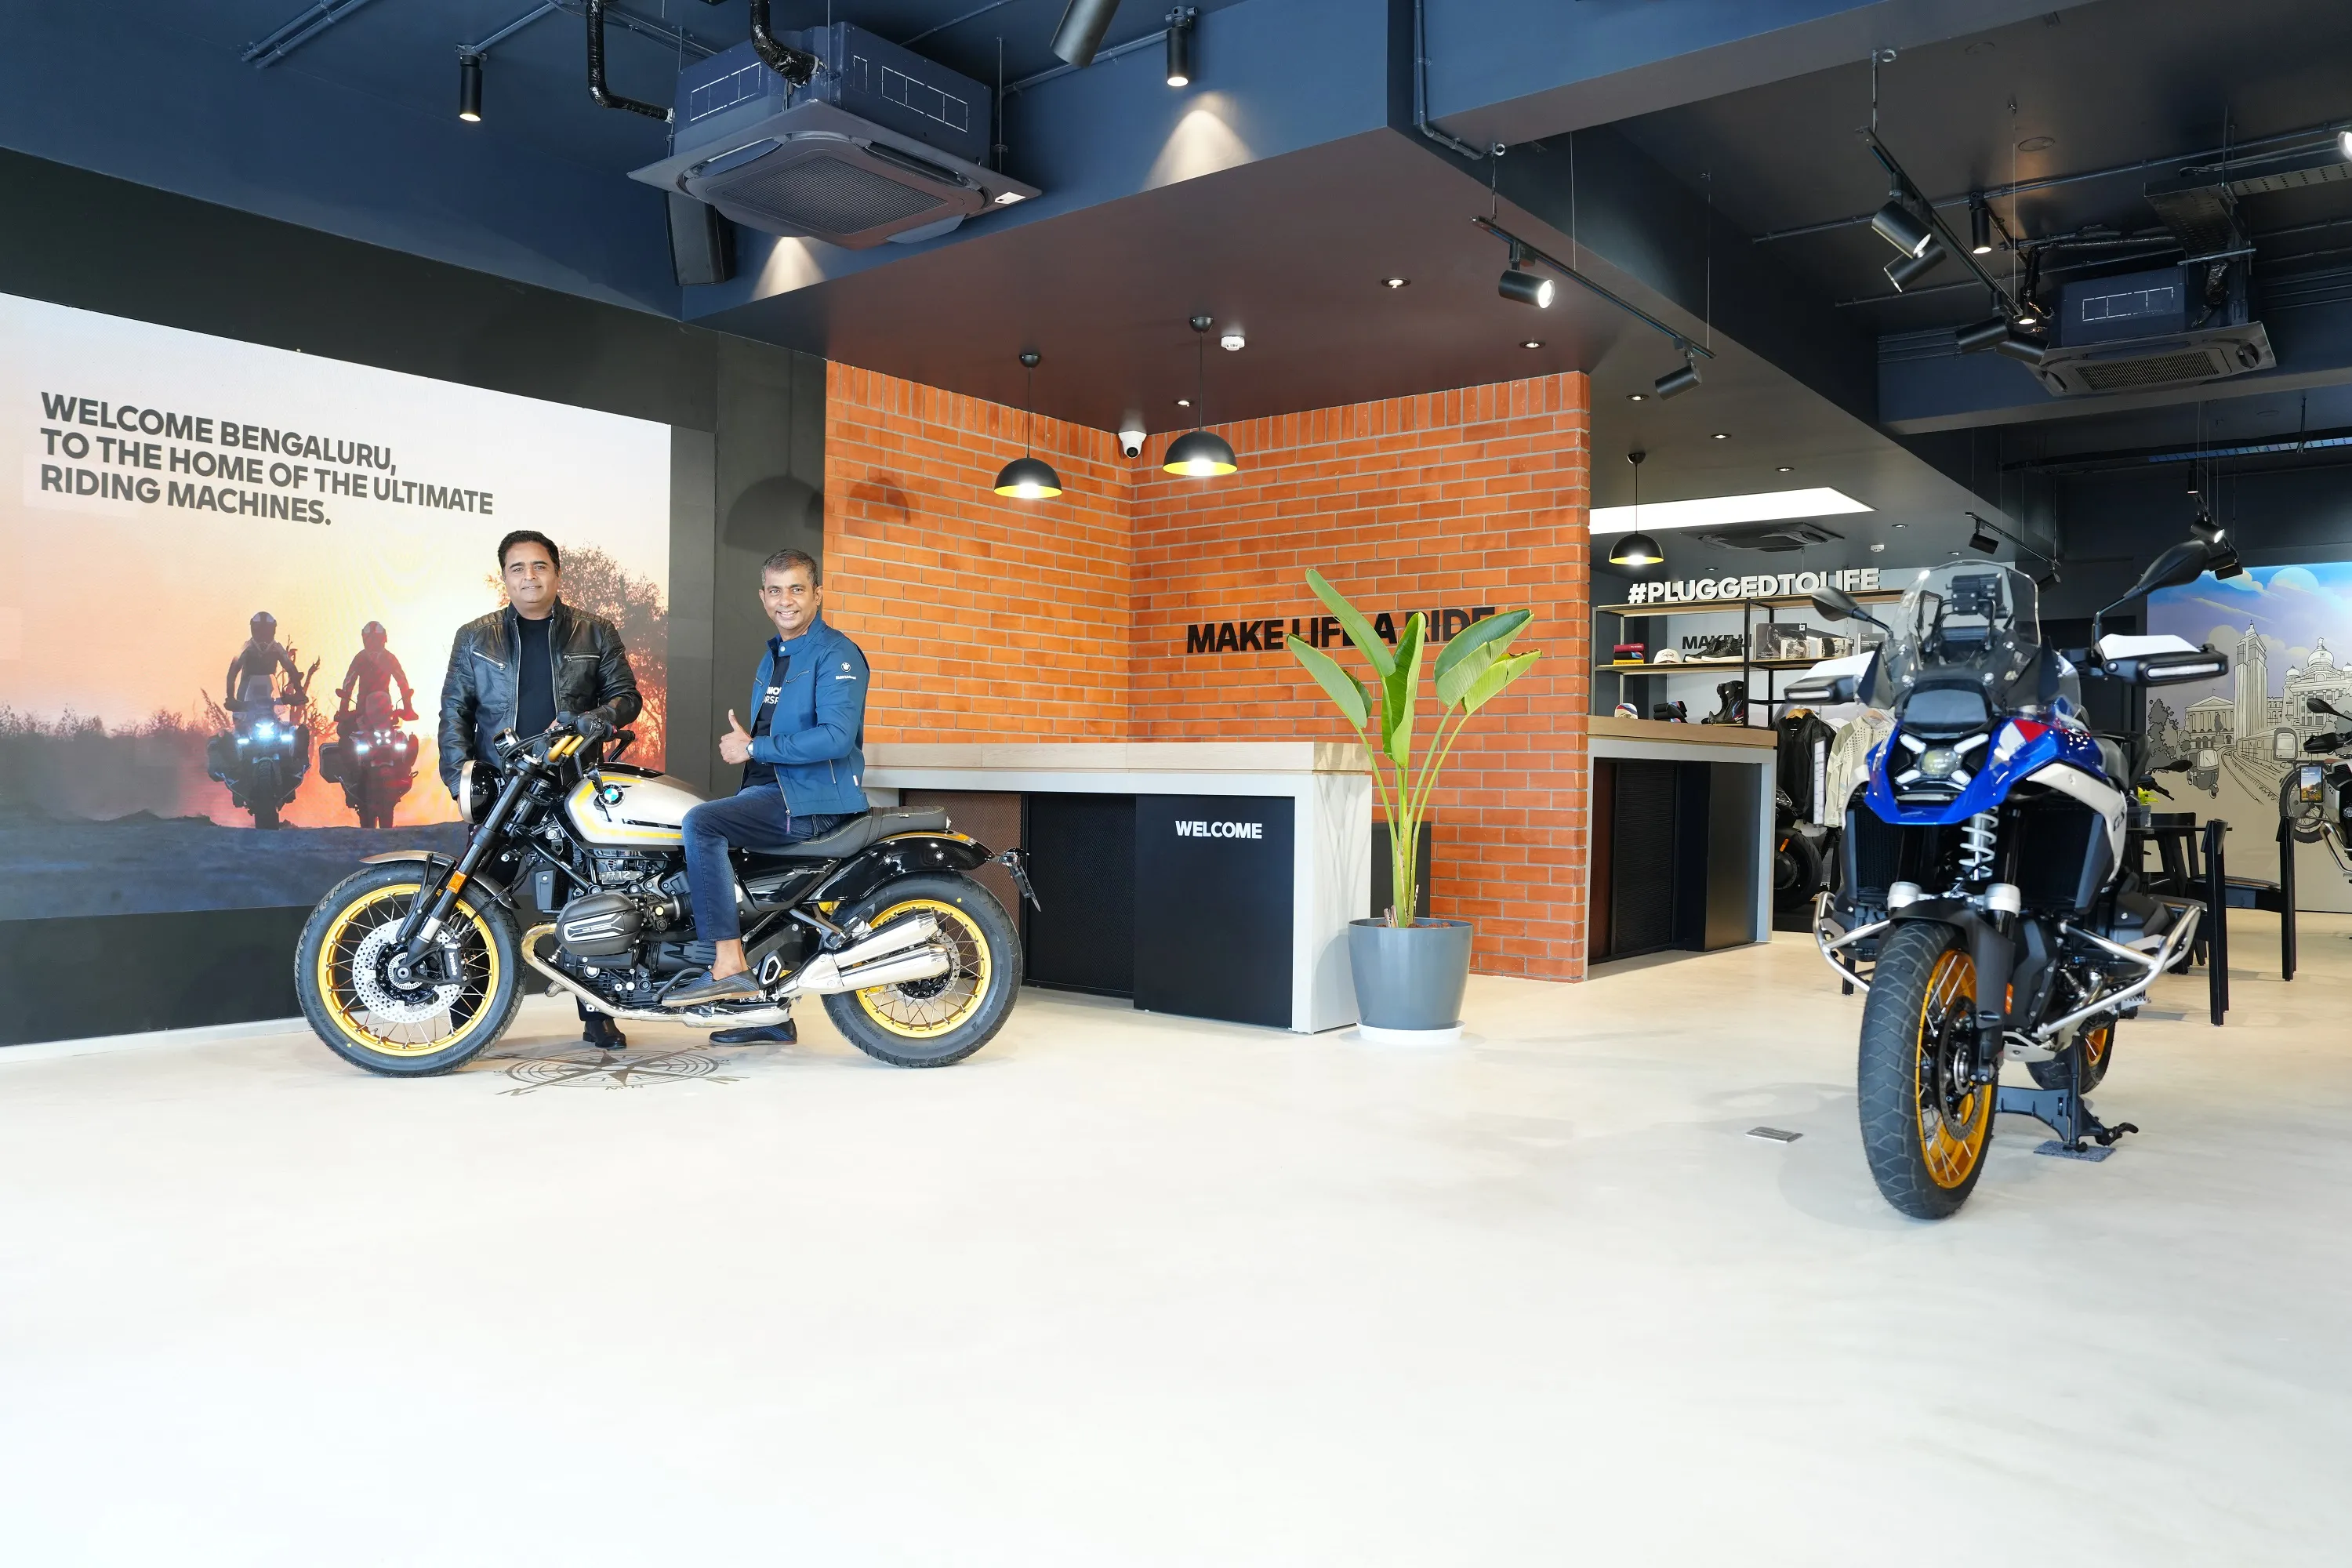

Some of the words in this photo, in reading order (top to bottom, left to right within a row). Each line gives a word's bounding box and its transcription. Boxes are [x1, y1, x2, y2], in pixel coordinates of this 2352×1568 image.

[41, 391, 213, 444] WELCOME
[220, 420, 396, 477] BENGALURU,
[40, 427, 90, 459] TO
[96, 435, 162, 470] THE
[169, 446, 263, 485] HOME
[269, 462, 308, 489] OF
[314, 468, 368, 499] THE
[373, 477, 494, 516] ULTIMATE
[41, 463, 161, 504] RIDING
[167, 481, 332, 526] MACHINES.
[1628, 568, 1880, 604] #PLUGGEDTOLIFE
[1187, 619, 1284, 653] MAKE
[1374, 612, 1398, 644] A
[1175, 820, 1262, 839] WELCOME
[448, 952, 458, 976] brembo
